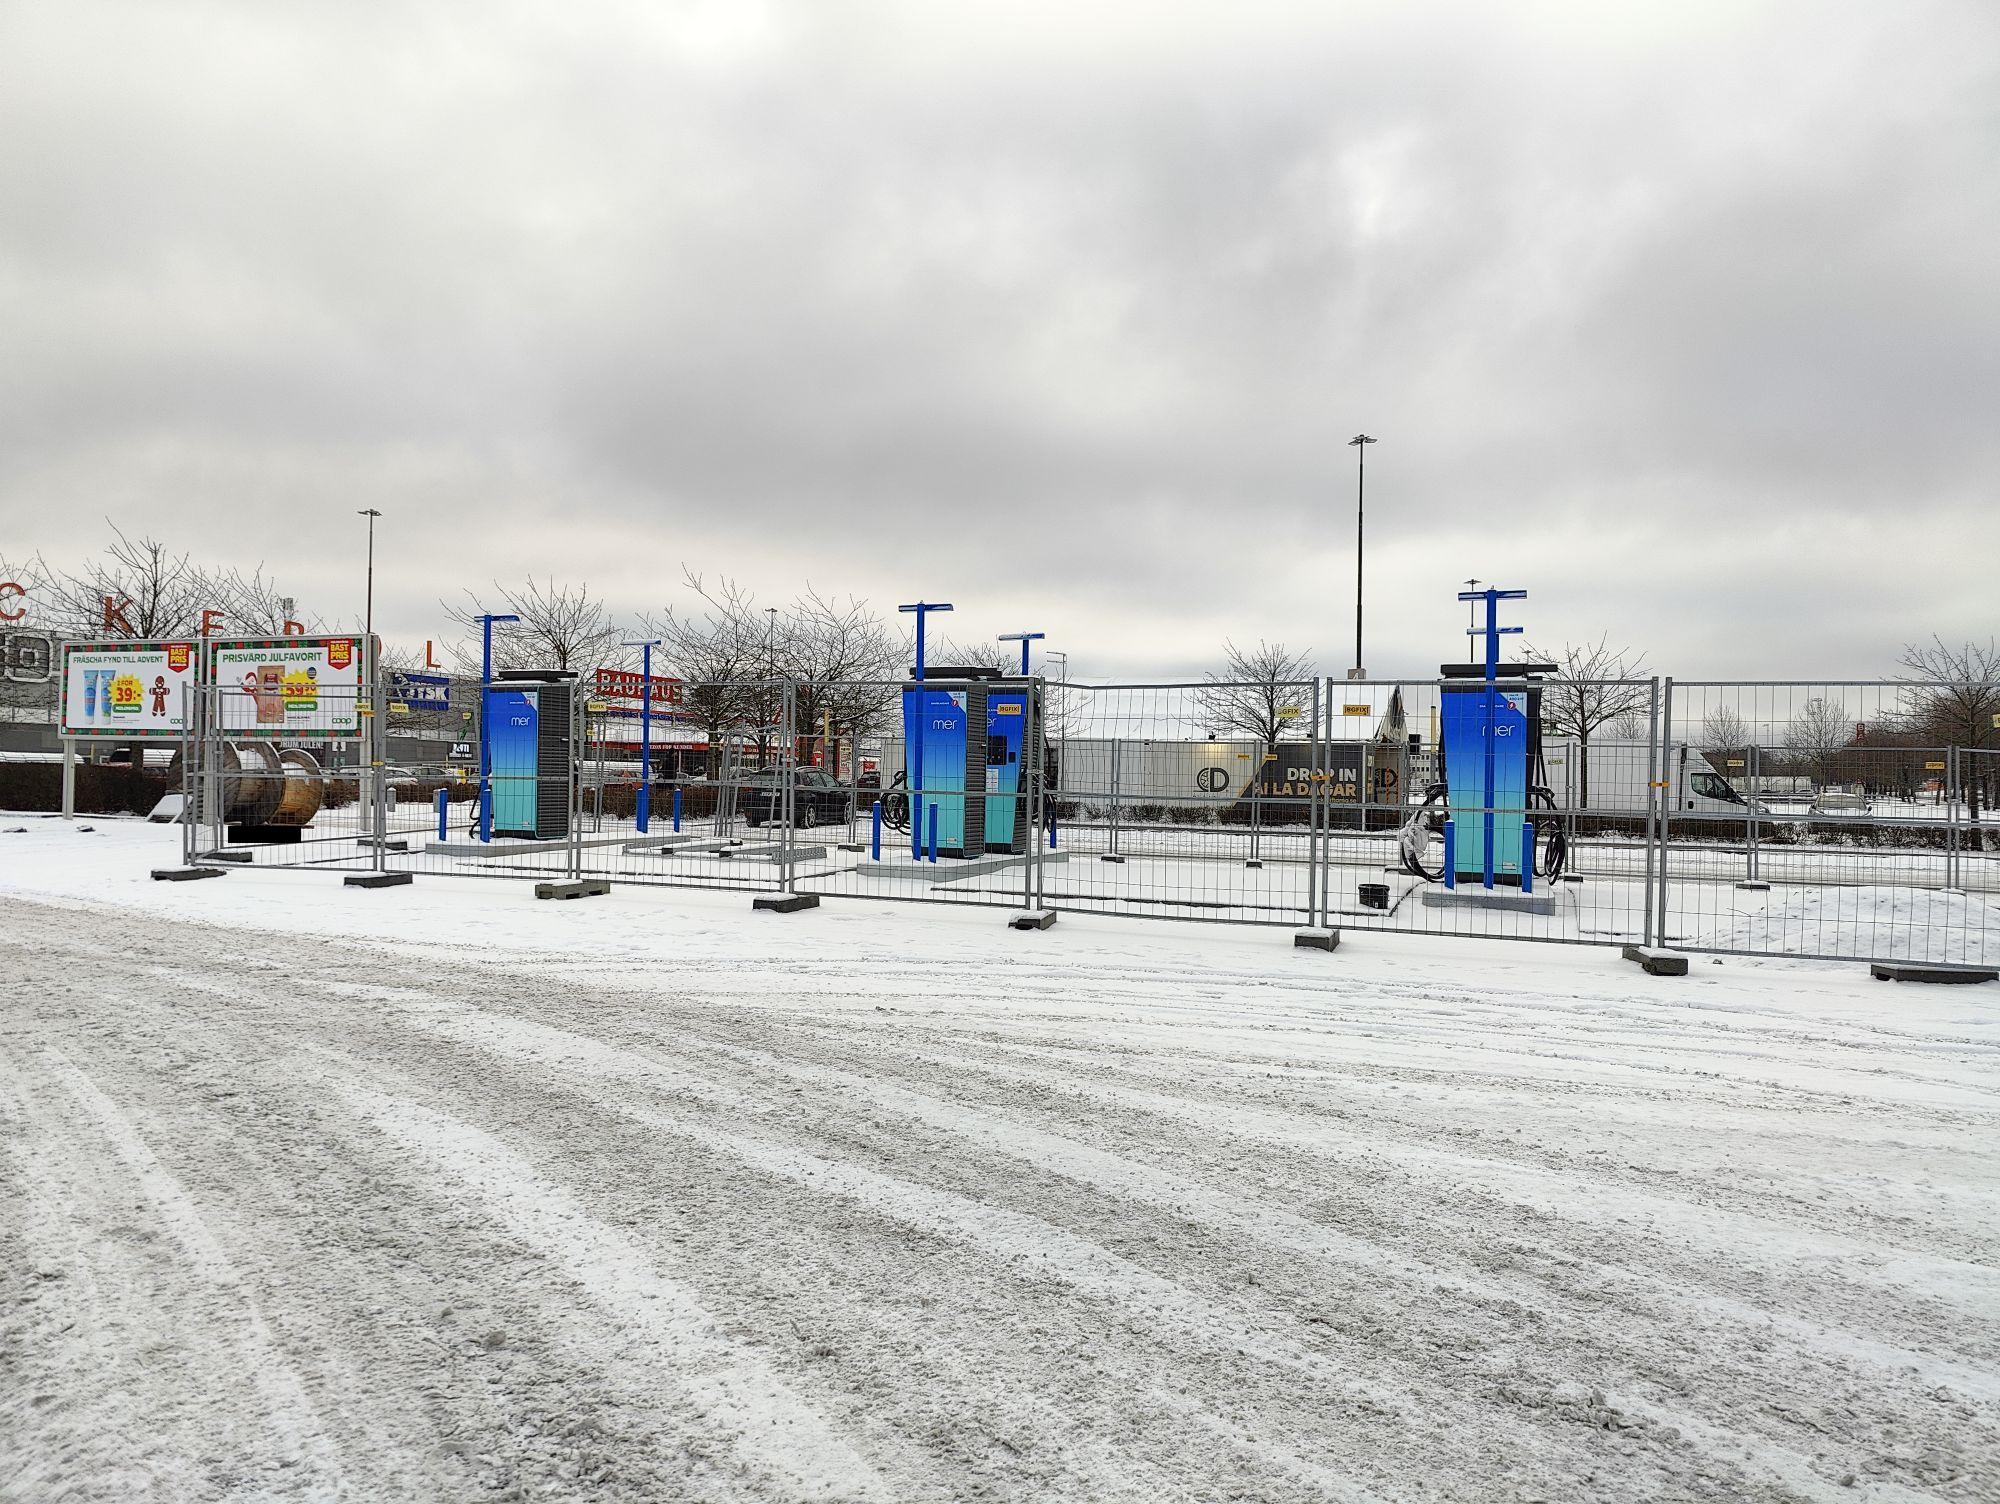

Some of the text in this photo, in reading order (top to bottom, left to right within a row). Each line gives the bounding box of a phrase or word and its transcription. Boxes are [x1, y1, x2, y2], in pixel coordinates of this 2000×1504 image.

[103, 656, 121, 664] FYND
[269, 652, 322, 662] JULFAVORIT
[331, 651, 349, 660] PRIS
[331, 717, 351, 725] coop
[511, 716, 530, 726] mer
[932, 719, 957, 730] mer
[1339, 768, 1357, 782] IN
